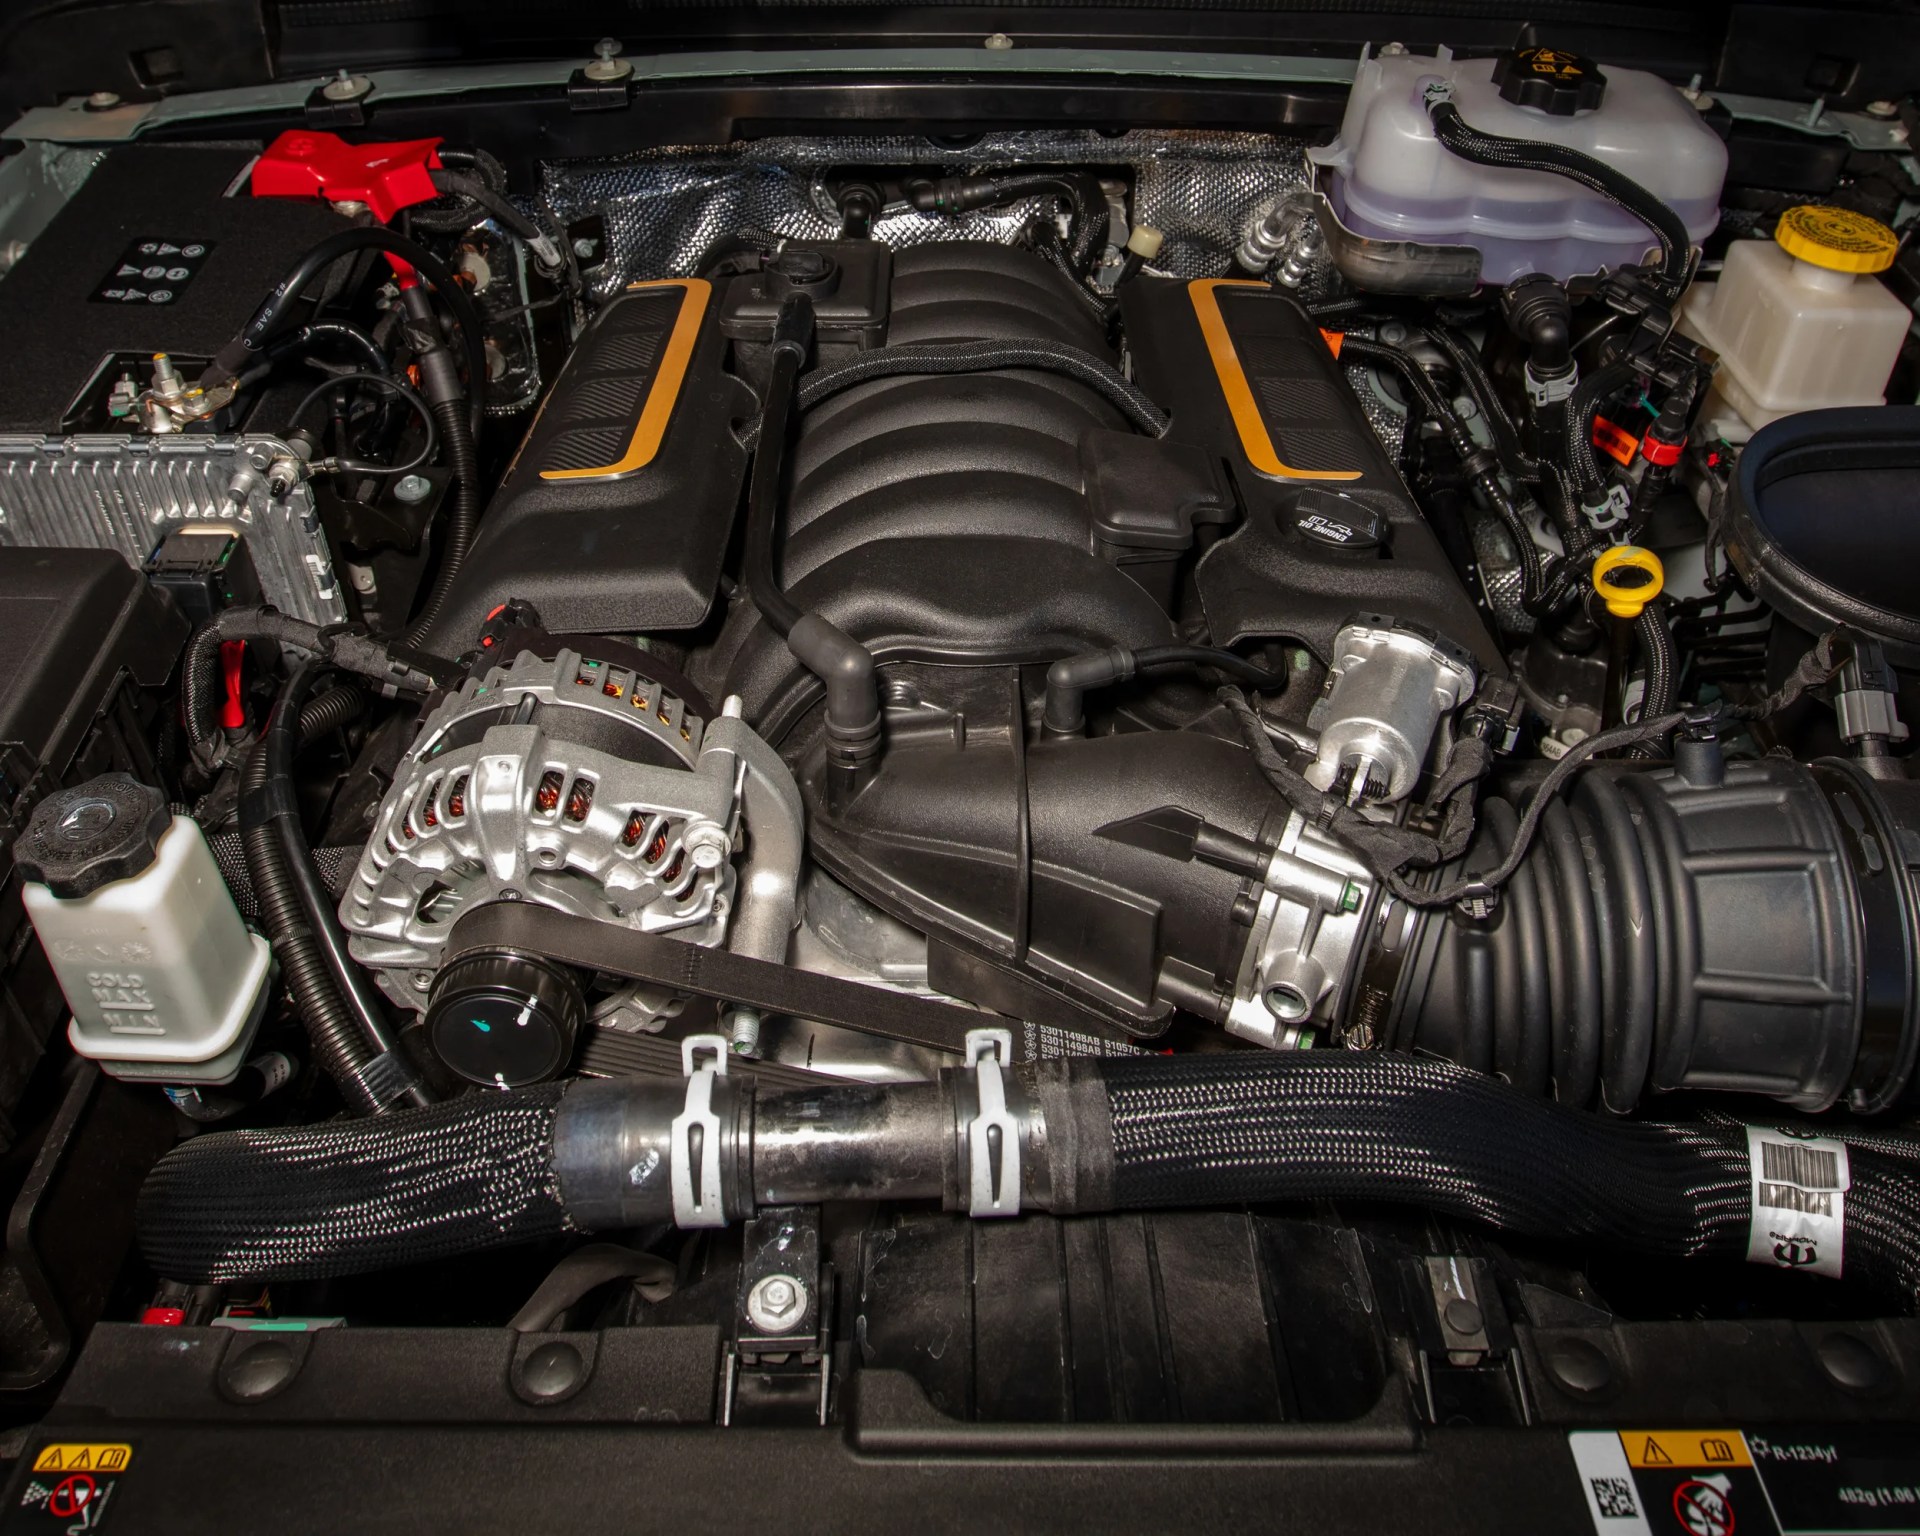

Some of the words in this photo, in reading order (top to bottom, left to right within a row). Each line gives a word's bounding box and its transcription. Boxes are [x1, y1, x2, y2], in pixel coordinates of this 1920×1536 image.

[275, 282, 287, 297] #2
[255, 307, 273, 332] SAE
[1298, 519, 1313, 529] OIL
[1312, 524, 1348, 542] ENGINE
[87, 972, 143, 988] COLD
[92, 988, 150, 1003] MAX
[103, 1013, 160, 1027] MIN
[1039, 1024, 1101, 1046] 53011498AB
[1104, 1039, 1140, 1056] 51057C
[1040, 1034, 1101, 1056] 53011498AB
